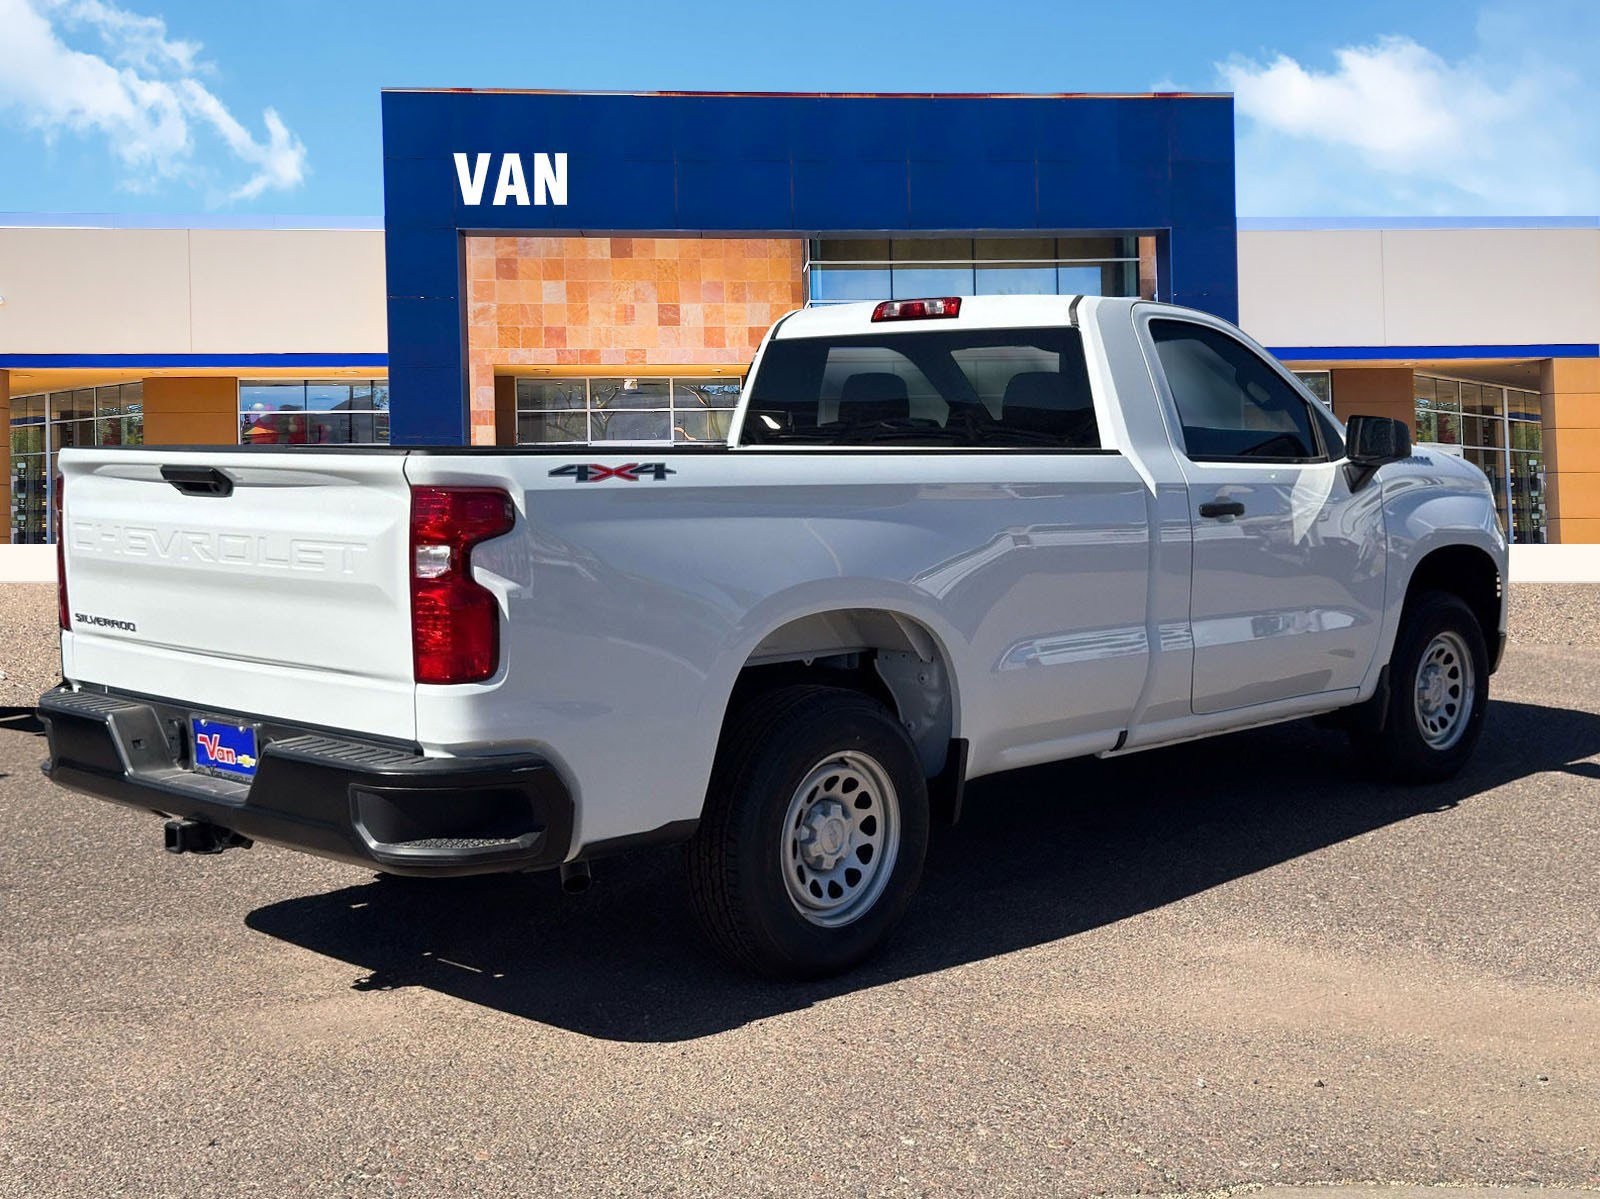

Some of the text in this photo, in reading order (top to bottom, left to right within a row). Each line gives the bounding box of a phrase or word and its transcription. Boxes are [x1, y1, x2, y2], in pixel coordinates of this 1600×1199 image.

[453, 153, 568, 206] VAN
[72, 521, 368, 575] CHEVROLET
[74, 612, 137, 632] SILVERADO
[197, 733, 237, 766] Van
